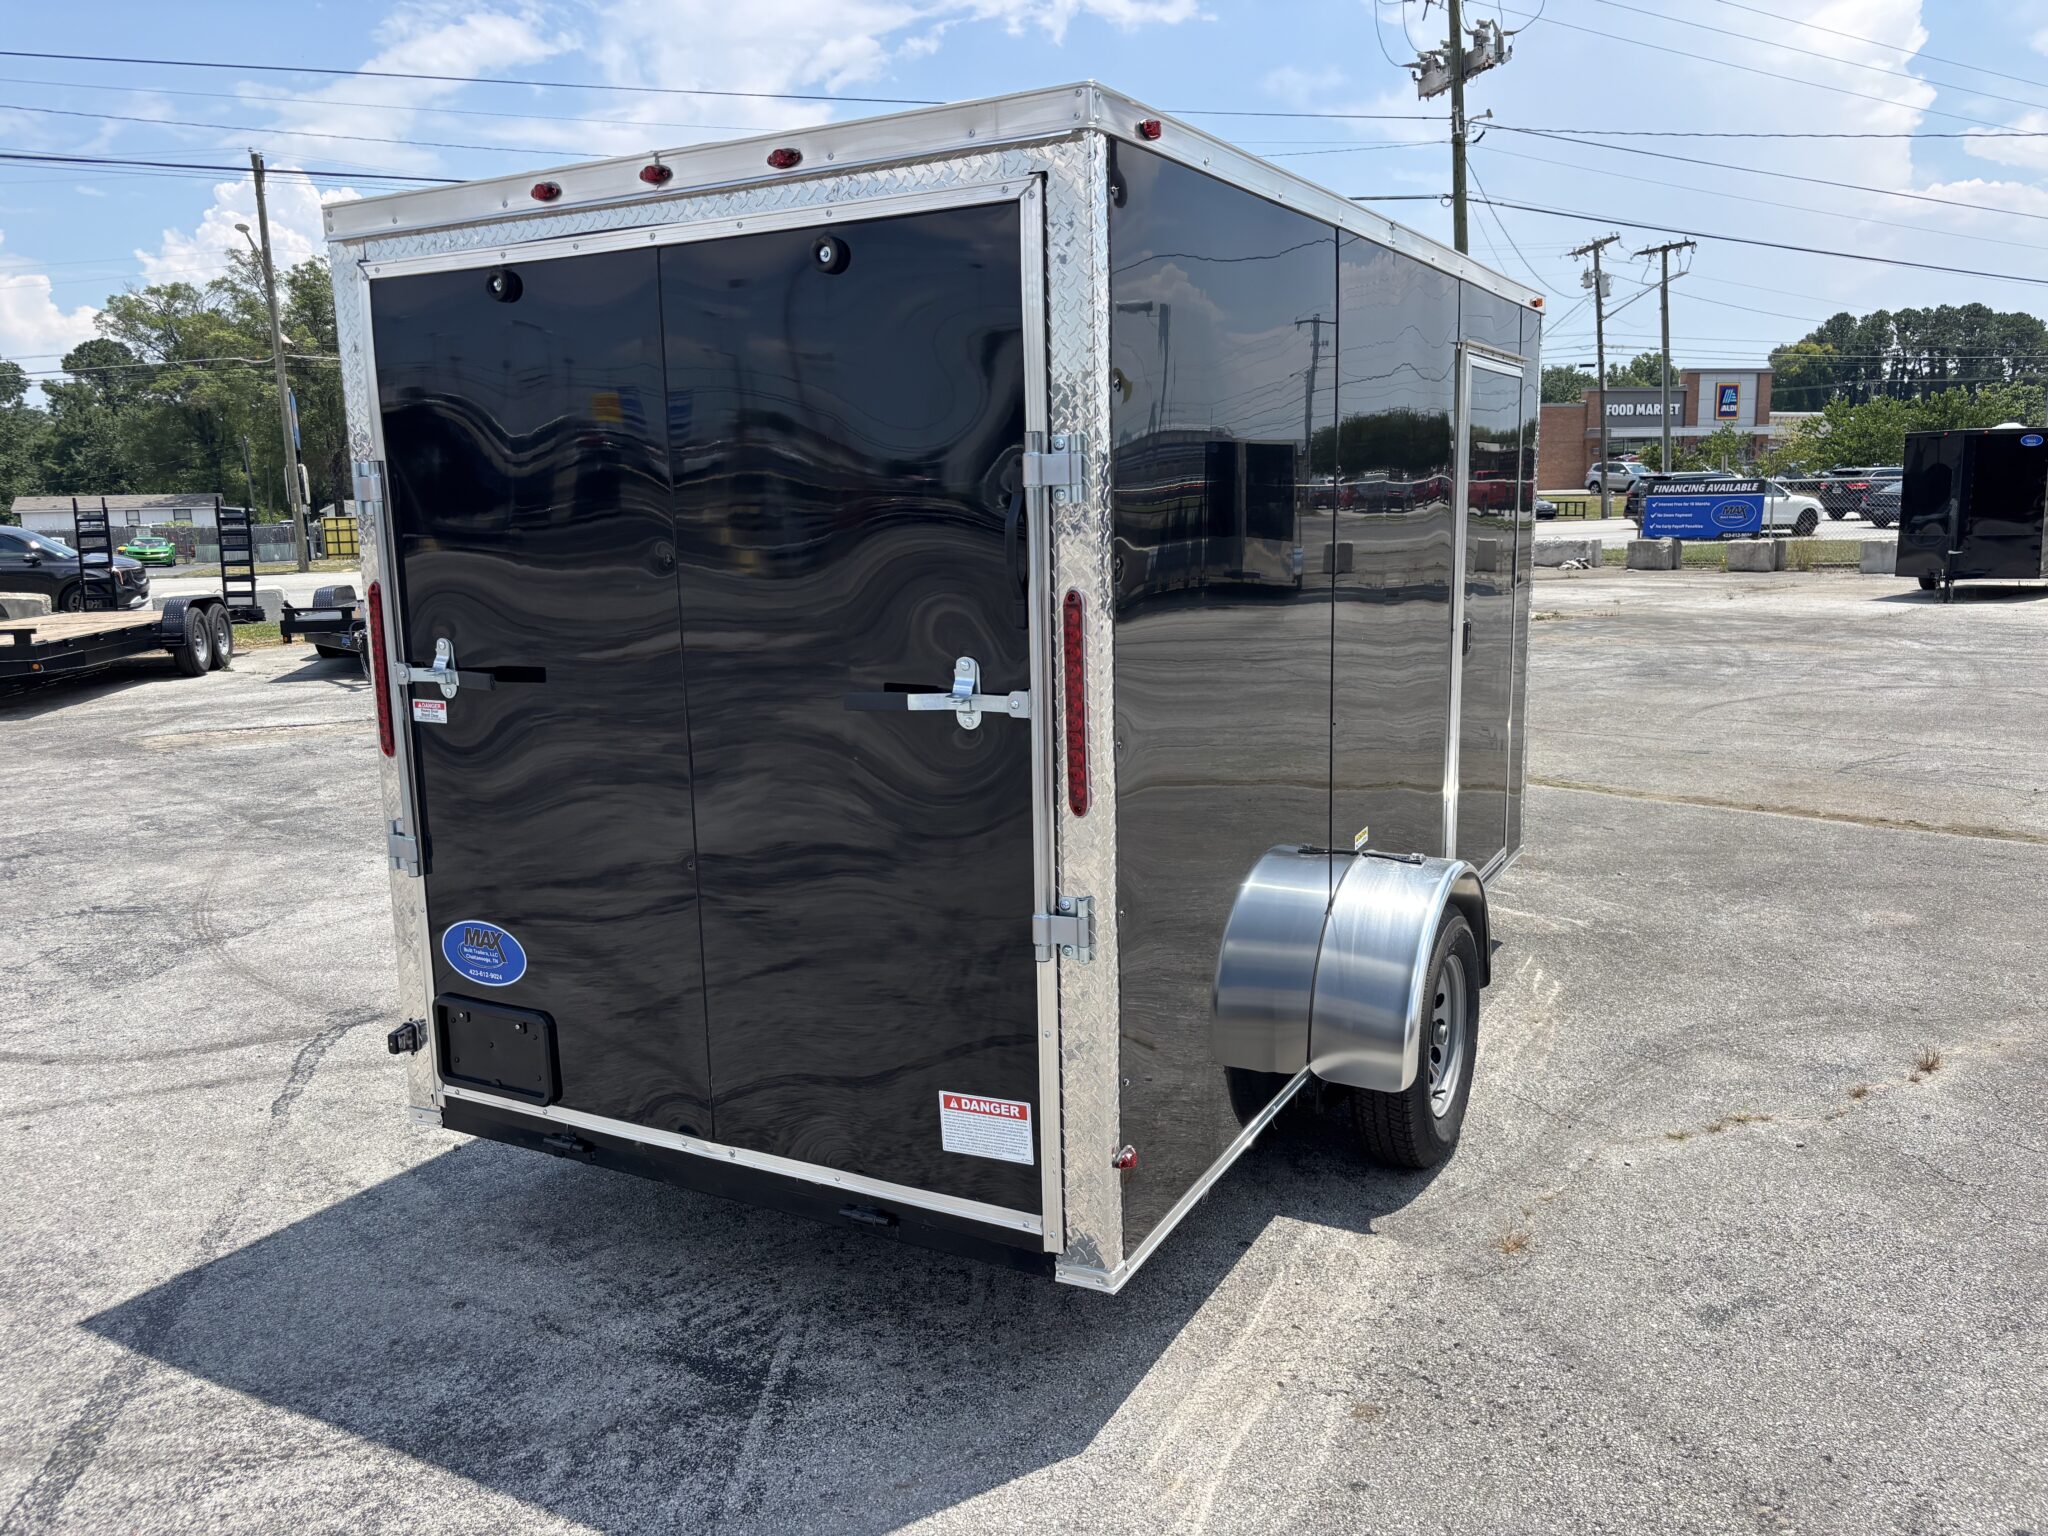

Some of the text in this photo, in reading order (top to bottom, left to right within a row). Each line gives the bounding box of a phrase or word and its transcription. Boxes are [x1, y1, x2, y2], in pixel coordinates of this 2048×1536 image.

[1606, 403, 1680, 416] FOOD MARET
[1720, 404, 1737, 412] ALDI
[1653, 482, 1759, 493] FINANCING AVAILABLE
[1722, 505, 1748, 519] MAX
[464, 927, 507, 961] MAX
[469, 969, 503, 980] 423-612-9024
[961, 1098, 1020, 1117] DANGER
